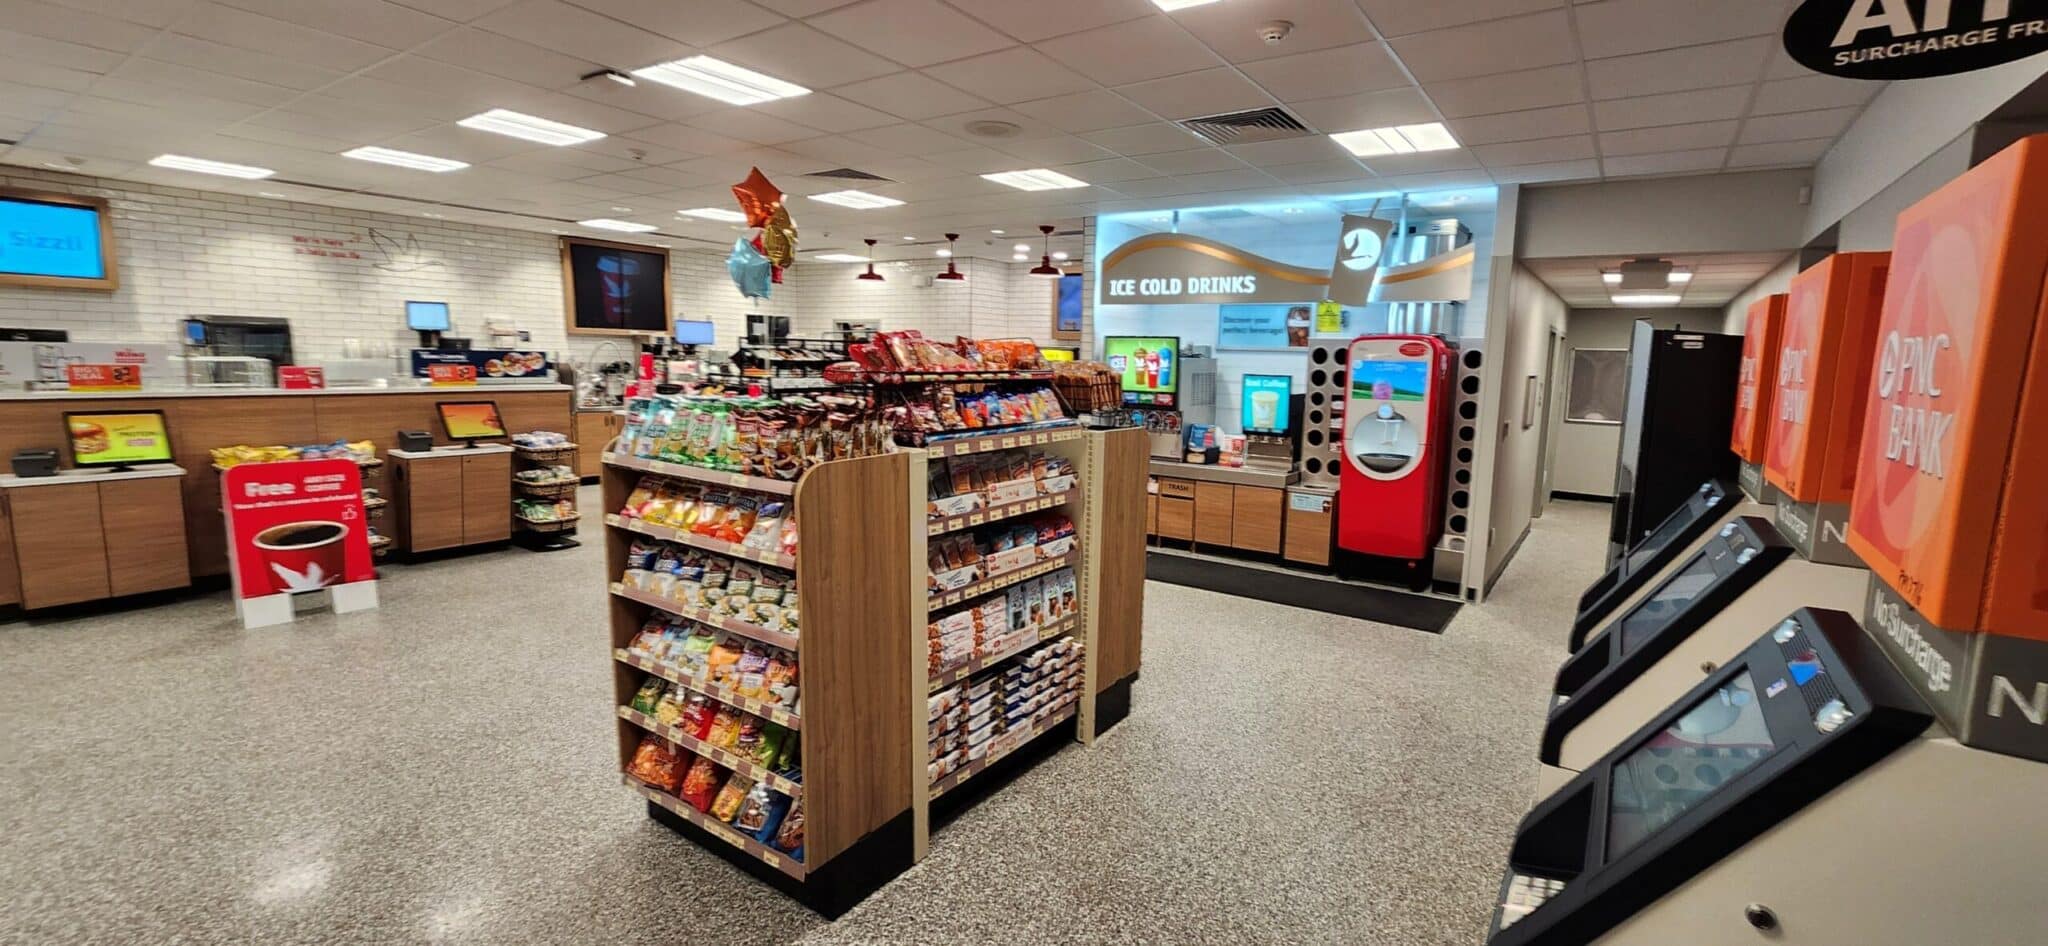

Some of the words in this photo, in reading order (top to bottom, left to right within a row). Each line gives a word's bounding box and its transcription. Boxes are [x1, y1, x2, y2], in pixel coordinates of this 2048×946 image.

[1834, 28, 1997, 66] SURCHARGE
[1109, 279, 1136, 296] ICE
[1140, 277, 1182, 295] COLD
[1188, 275, 1257, 294] DRINKS
[1898, 334, 1949, 397] PNC
[1887, 404, 1952, 479] BANK
[244, 482, 296, 497] Free
[1169, 483, 1189, 492] TRASH
[1873, 588, 1888, 627] No
[1887, 602, 1952, 692] Surcharge
